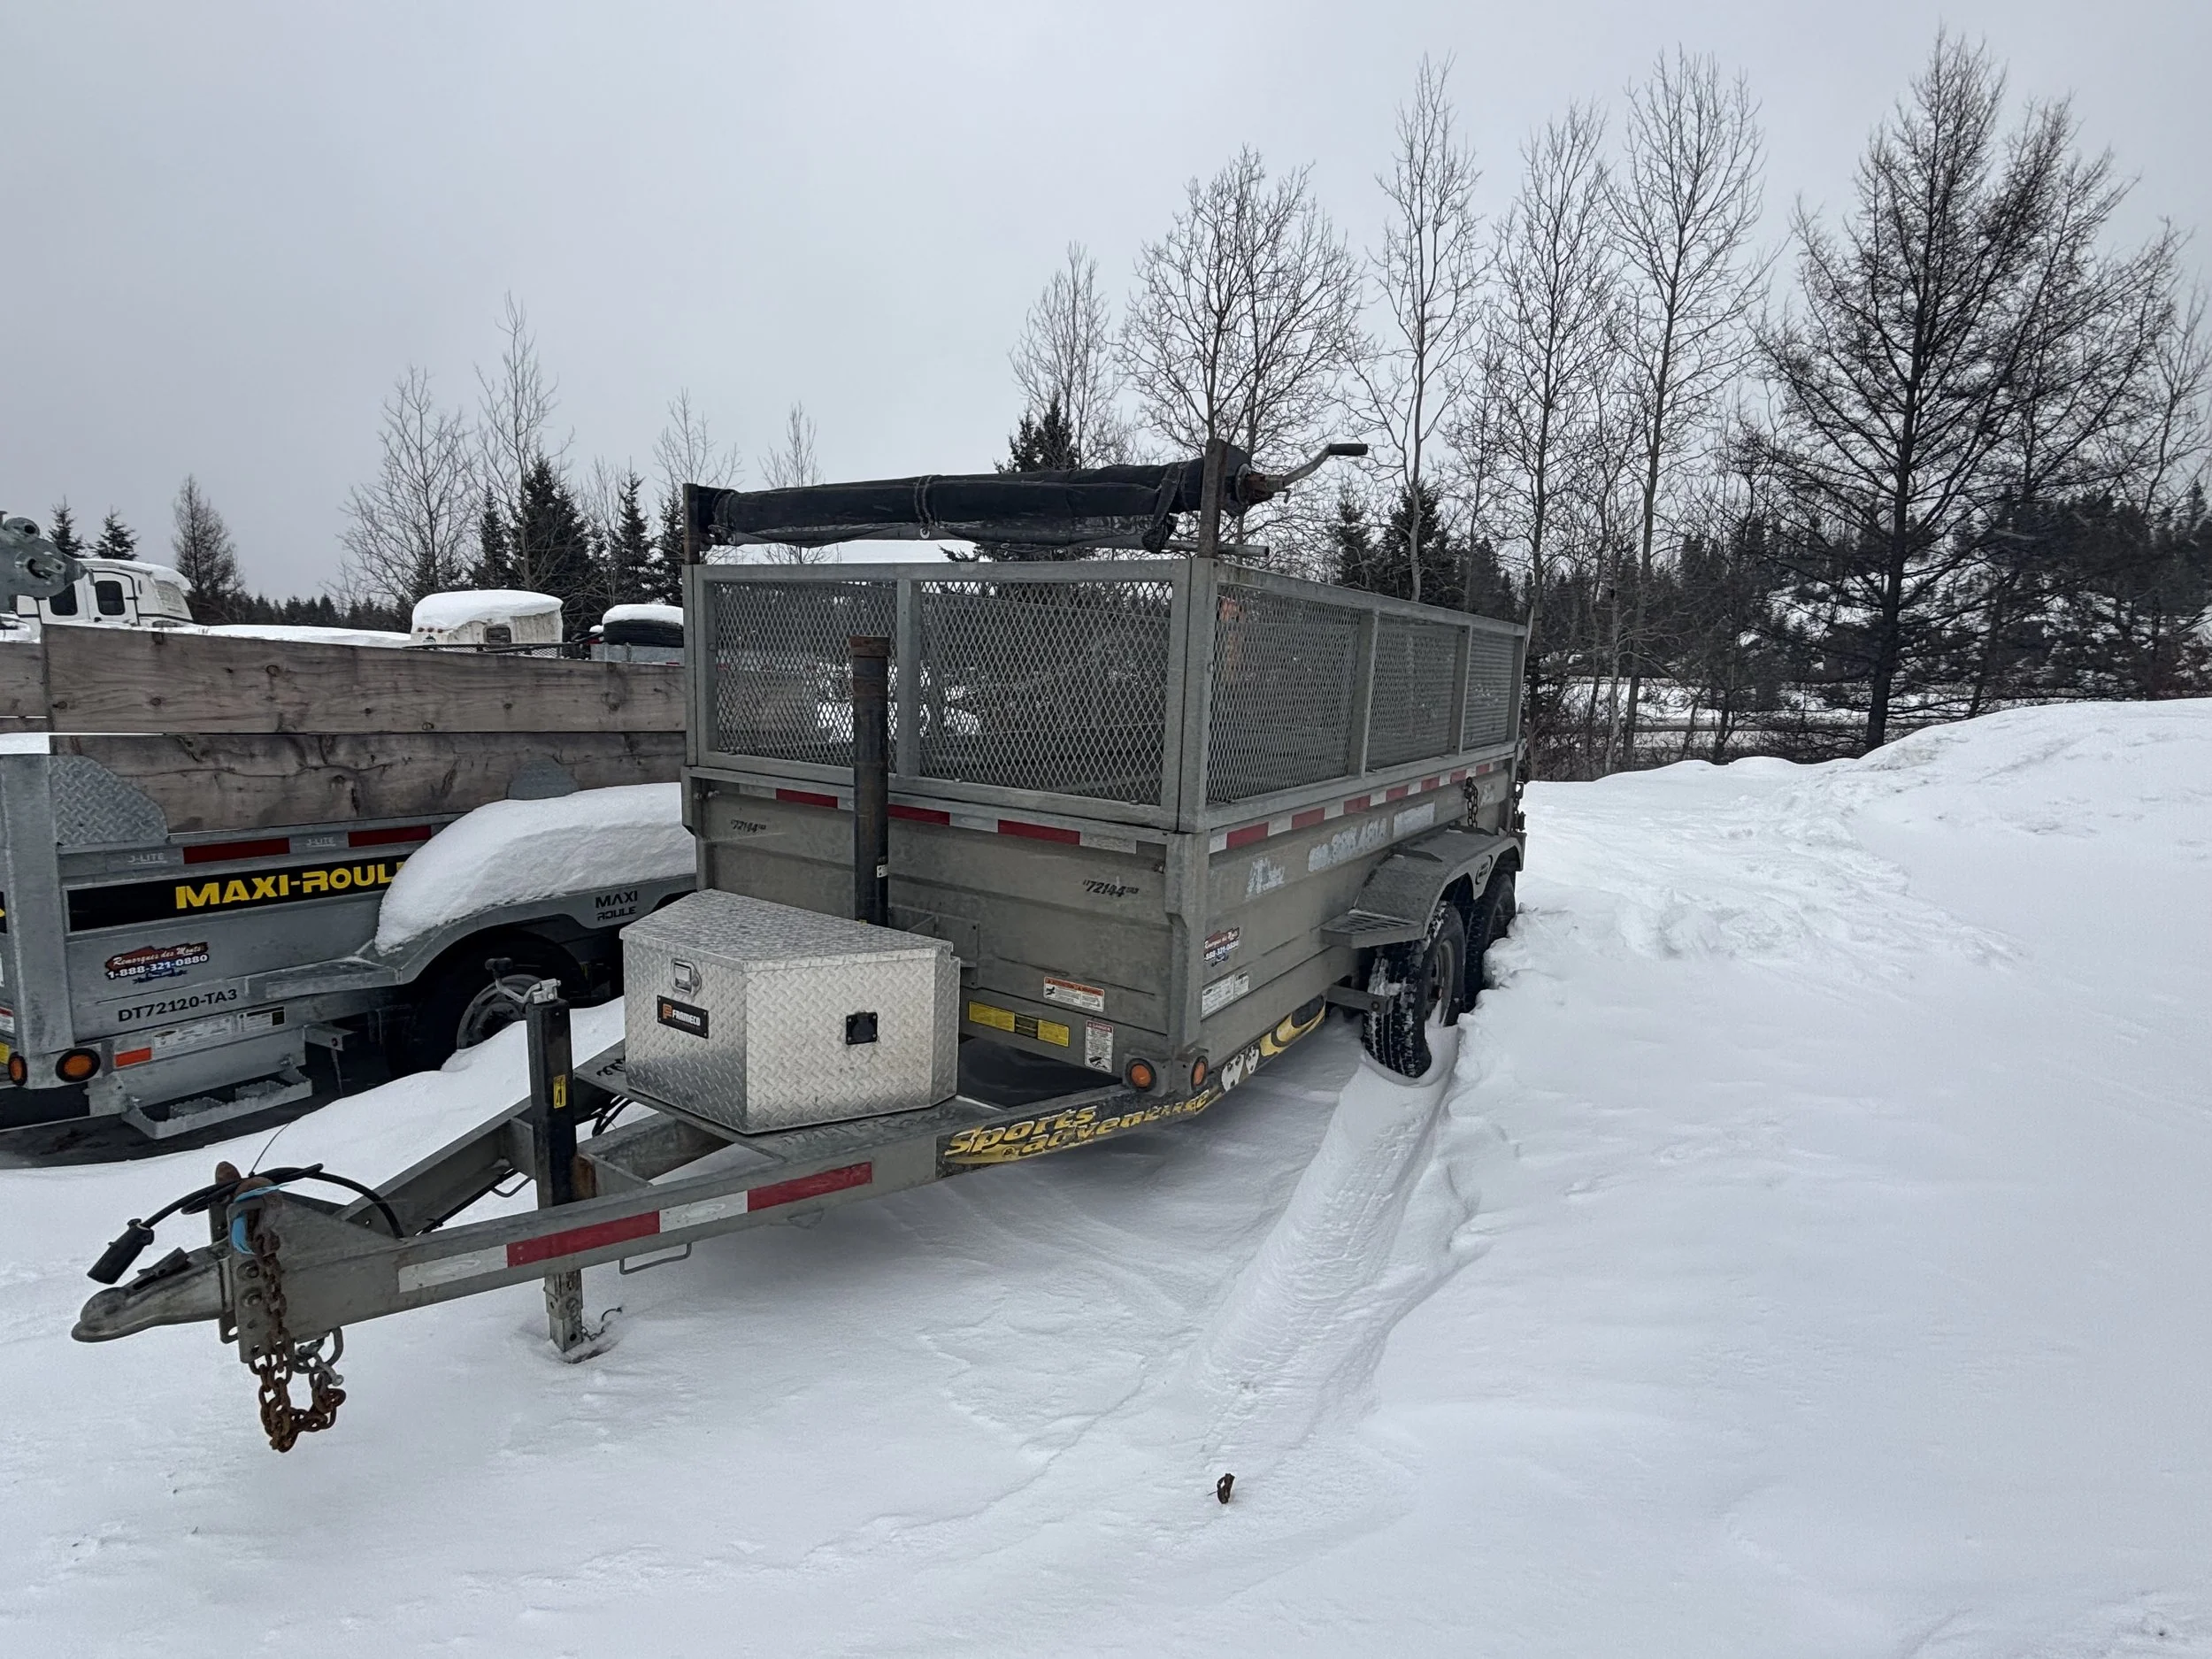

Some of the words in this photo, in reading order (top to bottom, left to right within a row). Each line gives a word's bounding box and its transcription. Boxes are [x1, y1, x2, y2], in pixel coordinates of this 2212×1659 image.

[175, 861, 404, 910] MAXI-ROUL
[595, 890, 638, 908] MAXI
[595, 906, 636, 921] ROULE
[107, 954, 208, 979] 1-888-321-0880
[112, 954, 158, 967] Remorques
[176, 946, 202, 956] Monts
[118, 988, 238, 1023] DT72120-TA3
[944, 1104, 1098, 1156] Sports
